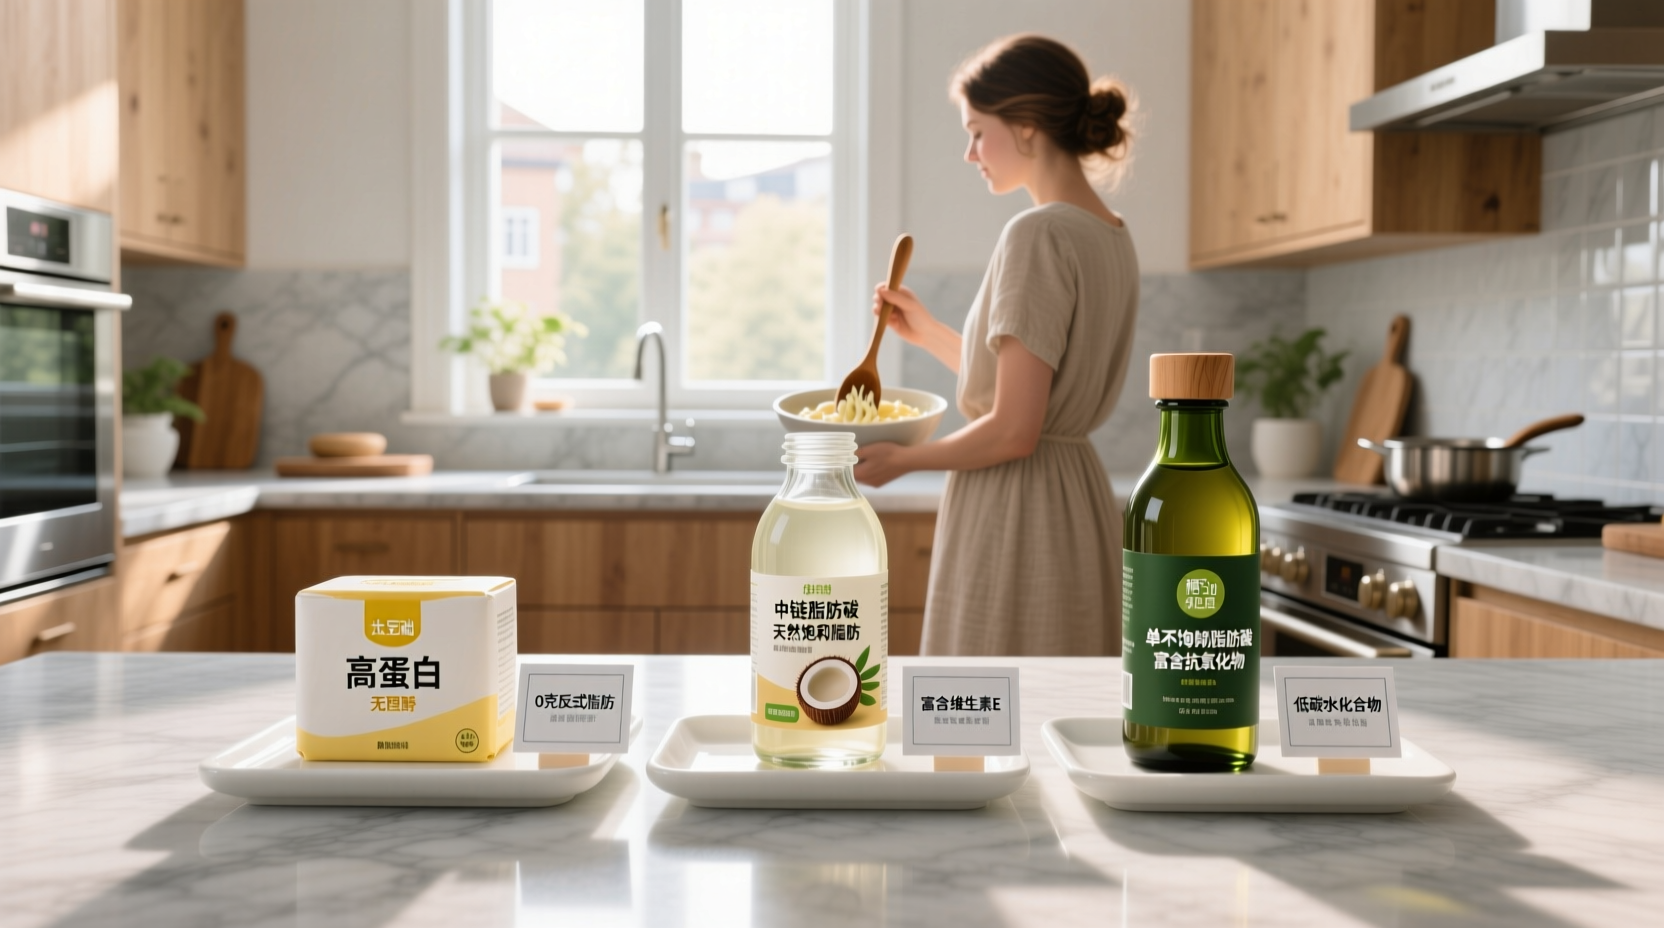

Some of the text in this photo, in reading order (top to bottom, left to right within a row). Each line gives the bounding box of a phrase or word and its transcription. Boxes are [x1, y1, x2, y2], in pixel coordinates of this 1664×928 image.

[346, 655, 440, 690] 高蛋白
[535, 692, 616, 710] 0克反式脂肪
[921, 695, 1001, 712] 富含维生素E
[1293, 695, 1382, 713] 低碳水化合物
